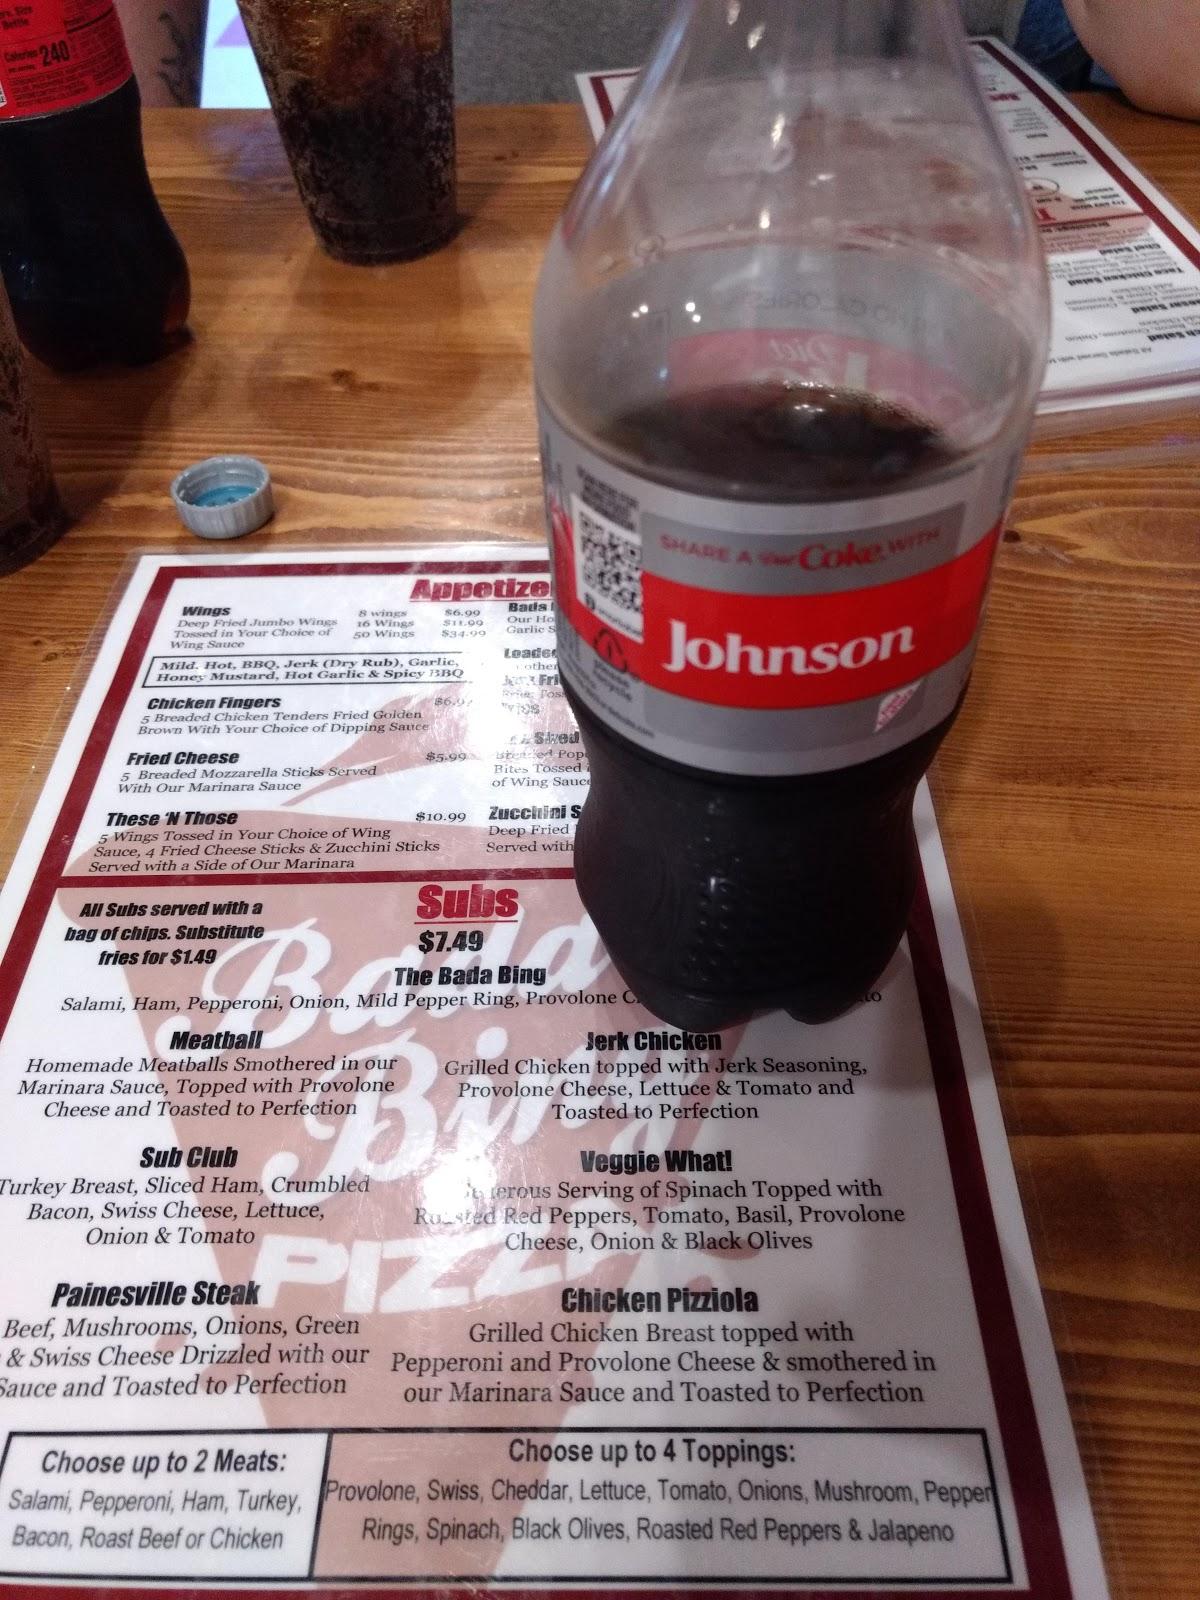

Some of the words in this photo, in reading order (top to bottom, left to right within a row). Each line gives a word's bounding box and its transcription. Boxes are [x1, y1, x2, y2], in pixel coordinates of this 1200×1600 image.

[38, 40, 70, 67] 240
[660, 533, 729, 563] SHARE
[736, 549, 752, 565] A
[888, 528, 942, 554] WITH
[409, 578, 553, 601] Appetize
[182, 606, 231, 618] Wings
[358, 609, 368, 618] 8
[370, 609, 408, 618] wings
[444, 609, 481, 618] $6.99
[508, 602, 547, 612] Bads
[177, 619, 210, 629] Deep
[213, 618, 246, 628] Fried
[249, 618, 295, 627] Jumbo
[299, 617, 338, 628] Wings
[356, 620, 370, 628] 16
[374, 619, 414, 629] Wings
[443, 619, 484, 628] $11.99
[506, 625, 544, 634] Garlic
[173, 629, 218, 639] Tossed
[221, 629, 234, 638] in
[237, 628, 268, 638] Your
[271, 627, 315, 637] Choice
[318, 627, 334, 637] of
[352, 630, 370, 640] 50
[374, 629, 415, 639] Wings
[441, 629, 487, 639] $34.99
[170, 640, 204, 651] Wing
[206, 639, 245, 649] Sauce
[663, 619, 916, 677] Johnson
[203, 660, 237, 671] Hot,
[242, 660, 280, 670] BBQ,
[284, 659, 319, 669] Jerk
[322, 658, 358, 670] (Dry
[362, 658, 404, 669] Rub),
[408, 657, 460, 668] Garlic,
[147, 697, 216, 710] Chicken
[218, 696, 282, 710] Fingers
[126, 752, 170, 766] Fried
[173, 751, 240, 765] Cheese
[425, 752, 467, 763] $5.99
[120, 772, 131, 782] 5
[138, 769, 197, 780] Breaded
[200, 768, 278, 779] Mozzarella
[281, 767, 324, 778] Sticks
[327, 766, 377, 777] Served
[105, 812, 160, 827] These
[184, 811, 239, 826] Those
[415, 812, 467, 823] $10.99
[488, 804, 566, 821] Zucchini
[93, 847, 141, 859] Sauce,
[146, 848, 155, 859] 4
[160, 845, 202, 857] Fried
[205, 844, 258, 856] Cheese
[260, 843, 306, 855] Sticks
[308, 844, 322, 855] &
[326, 842, 393, 854] Zucchini
[395, 841, 441, 853] Sticks
[79, 903, 104, 917] All
[105, 902, 148, 917] Subs
[150, 901, 210, 916] served
[212, 901, 248, 915] with
[251, 902, 264, 915] a
[416, 883, 519, 920] Subs
[64, 927, 98, 943] bag
[100, 926, 121, 941] of
[120, 925, 172, 942] chips.
[176, 925, 266, 940] Substitute
[418, 929, 484, 954] $7.49
[98, 950, 139, 966] fries
[142, 950, 168, 965] for
[170, 948, 218, 966] $1.49
[394, 967, 434, 987] The
[438, 966, 493, 986] Bada
[497, 965, 547, 986] Bing
[60, 997, 126, 1014] Salami,
[132, 997, 181, 1013] Ham,
[187, 995, 284, 1015] Pepperoni,
[289, 994, 350, 1010] Onion,
[356, 993, 402, 1008] Mild
[404, 993, 468, 1013] Pepper
[472, 991, 520, 1010] Ring,
[526, 990, 617, 1005] Provolone
[169, 1030, 264, 1050] Meatball
[586, 1031, 630, 1051] Jerk
[634, 1031, 722, 1051] Chicken
[25, 1057, 133, 1074] Homemade
[138, 1056, 229, 1072] Meatballs
[233, 1055, 335, 1072] Smothered
[341, 1056, 360, 1071] in
[363, 1057, 398, 1070] our
[444, 1058, 509, 1077] Grilled
[514, 1058, 591, 1076] Chicken
[597, 1057, 662, 1078] topped
[667, 1057, 709, 1074] with
[714, 1057, 758, 1074] Jerk
[763, 1056, 868, 1077] Seasoning,
[139, 1146, 183, 1169] Sub
[186, 1146, 239, 1169] Club
[580, 1150, 661, 1175] Veggie
[664, 1149, 733, 1173] What!
[51, 1280, 188, 1308] Painesville
[191, 1280, 261, 1307] Steak
[561, 1287, 662, 1314] Chicken
[667, 1287, 760, 1313] Pizziola
[508, 1439, 594, 1463] Choose
[599, 1442, 629, 1468] up
[634, 1440, 657, 1463] to
[663, 1440, 678, 1462] 4
[682, 1439, 797, 1468] Toppings:
[41, 1449, 126, 1475] Choose
[132, 1454, 160, 1479] up
[166, 1450, 189, 1473] to
[194, 1449, 208, 1473] 2
[213, 1449, 288, 1473] Meats:
[8, 1489, 74, 1516] Salami,
[80, 1489, 175, 1517] Pepperoni,
[182, 1488, 229, 1514] Ham,
[237, 1488, 303, 1516] Turkey,
[325, 1480, 421, 1505] Provolone,
[426, 1480, 483, 1504] Swiss,
[491, 1480, 574, 1505] Cheddar,
[579, 1479, 651, 1505] Lettuce,
[657, 1480, 733, 1505] Tomato,
[738, 1480, 810, 1506] Onions,
[814, 1480, 920, 1506] Mushroom,
[924, 1481, 996, 1508] Pepper
